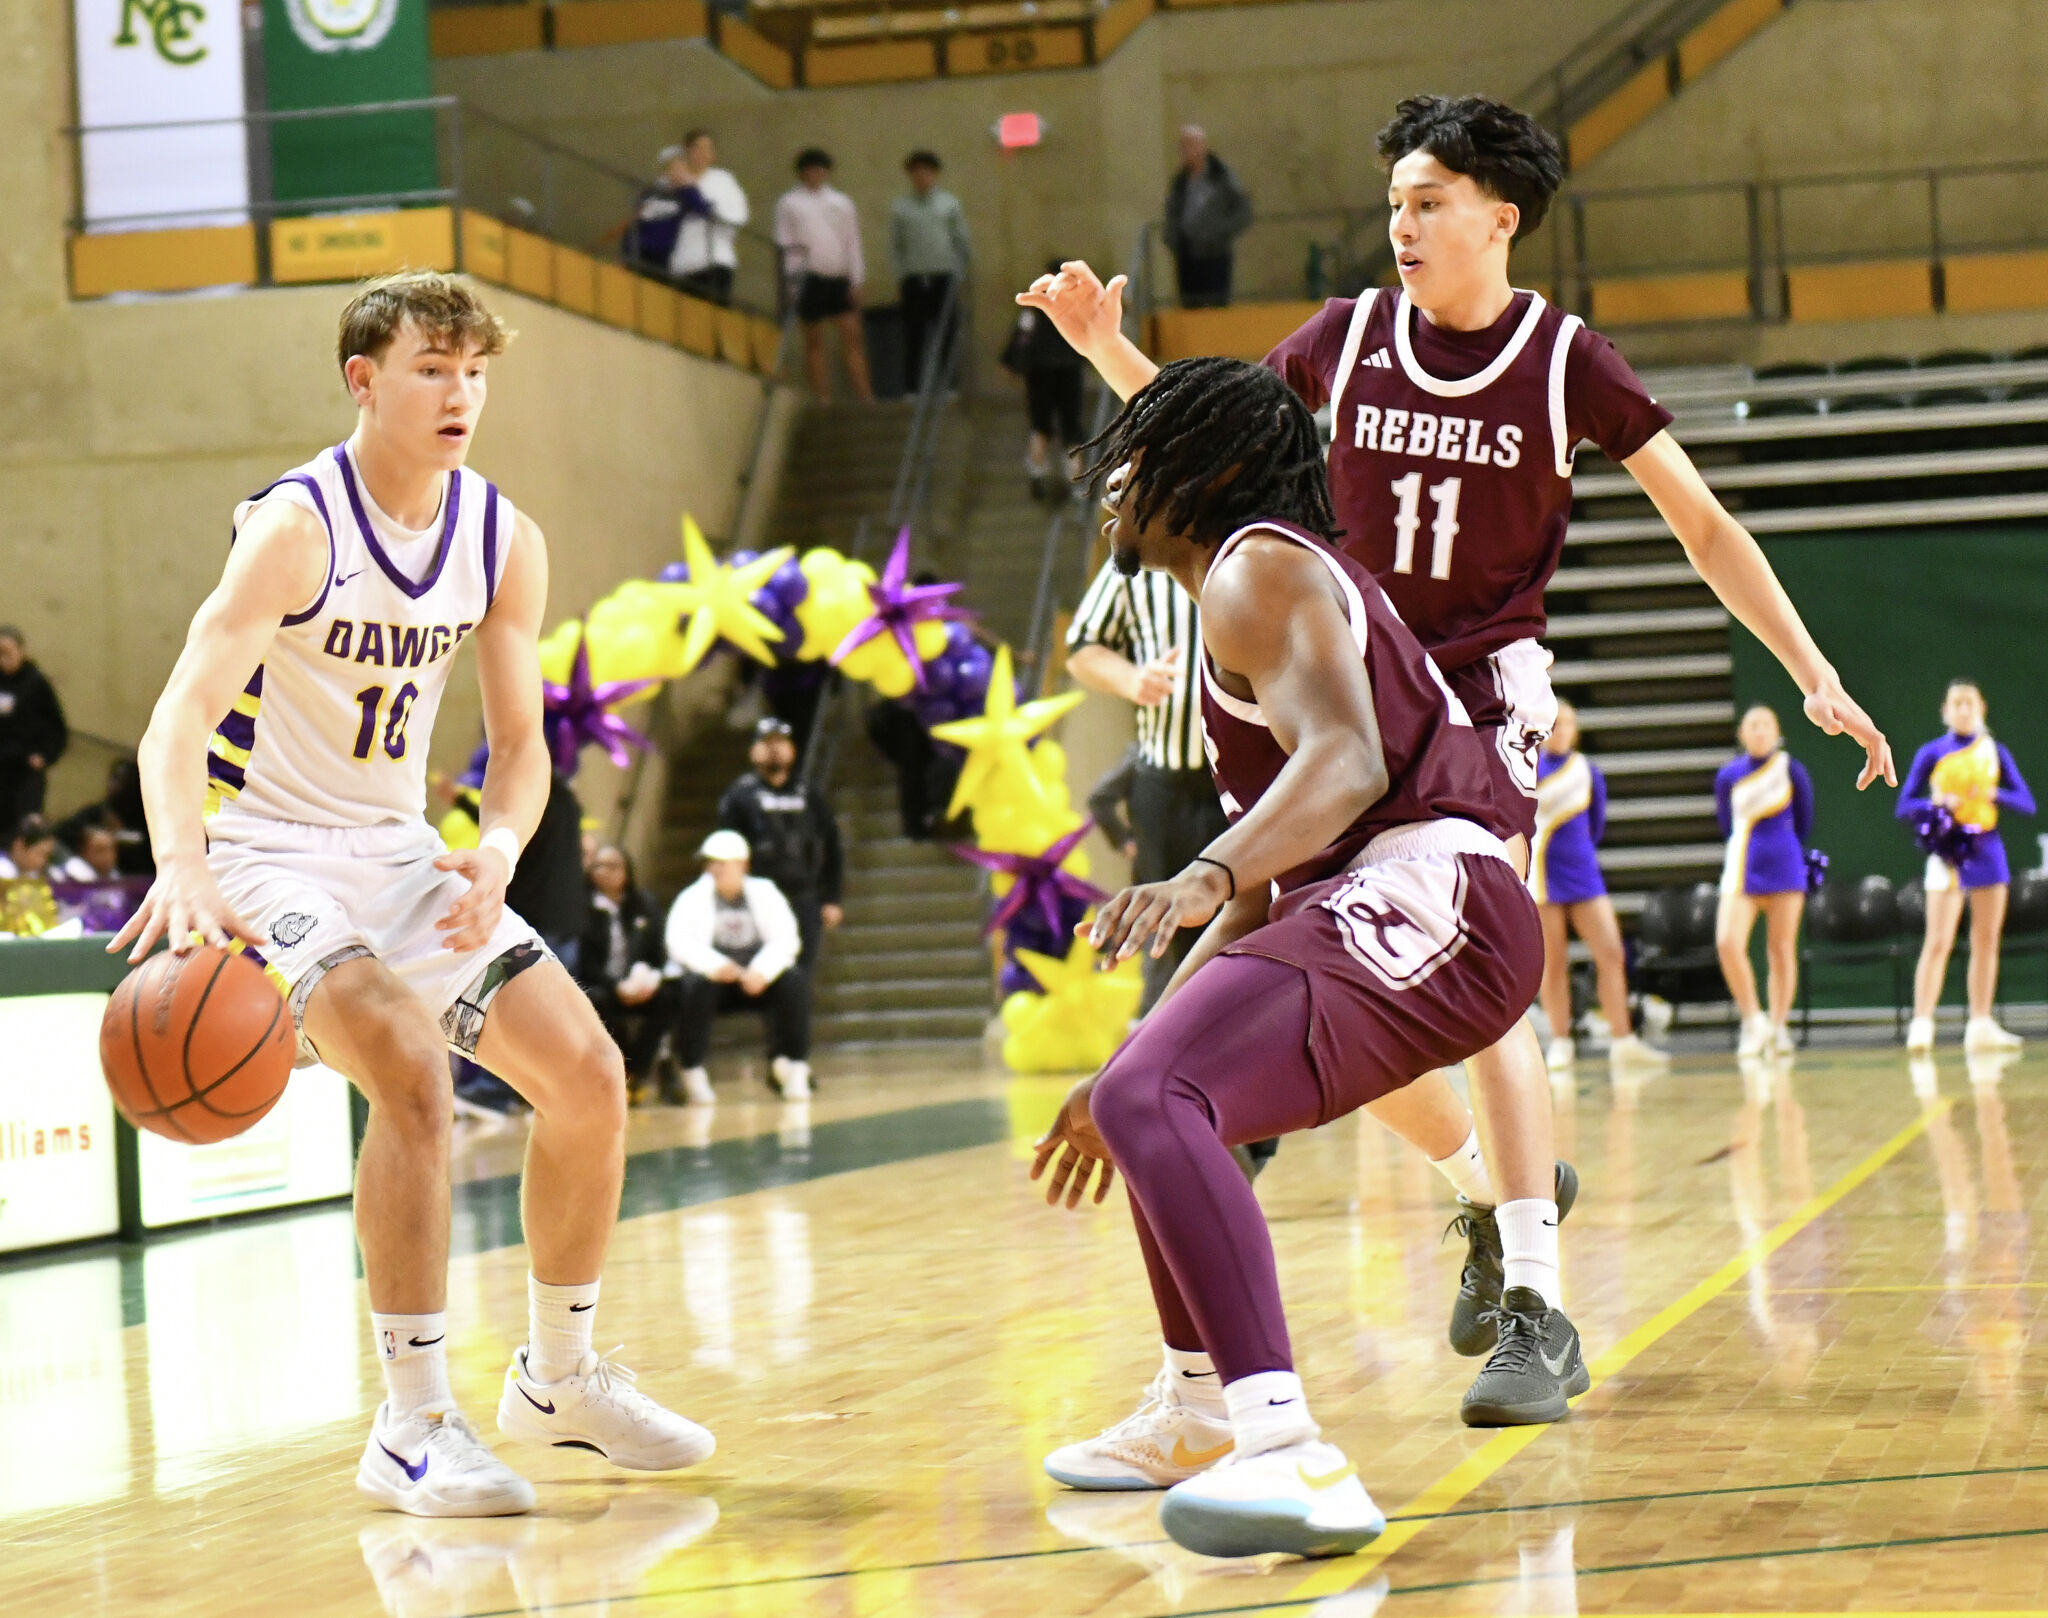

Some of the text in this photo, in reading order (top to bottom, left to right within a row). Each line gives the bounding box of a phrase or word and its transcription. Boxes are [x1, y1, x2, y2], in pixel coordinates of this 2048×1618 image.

[1354, 403, 1524, 469] REBELS
[1390, 471, 1463, 581] 11
[352, 680, 420, 764] 10
